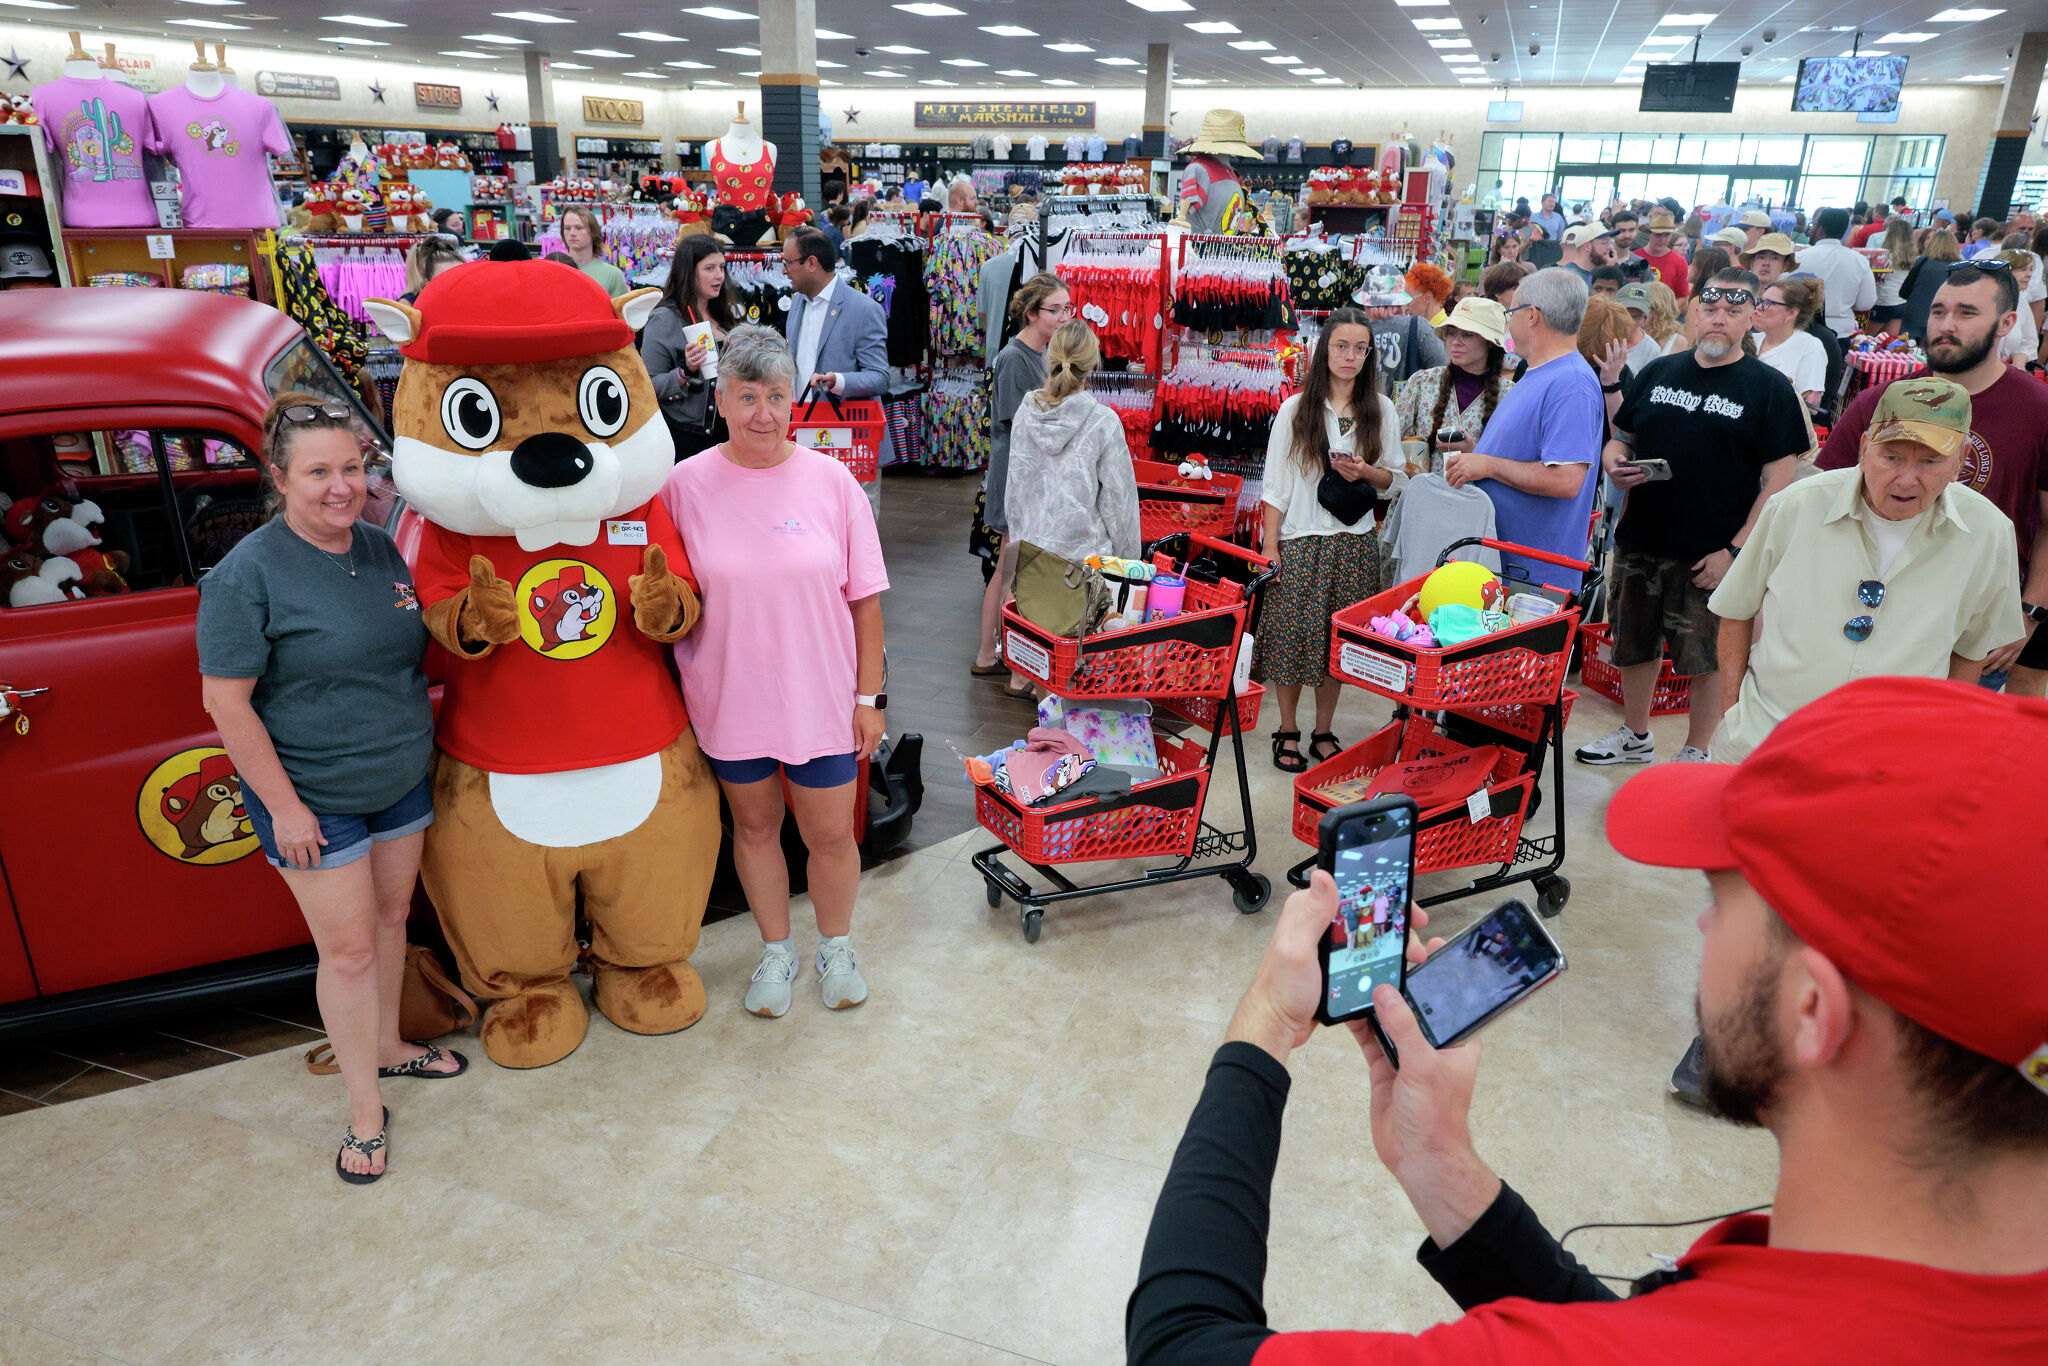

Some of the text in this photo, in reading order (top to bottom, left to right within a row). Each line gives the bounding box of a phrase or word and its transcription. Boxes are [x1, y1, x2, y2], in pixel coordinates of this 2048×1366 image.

[418, 86, 460, 104] STORE
[586, 99, 643, 121] WOOL
[923, 104, 1087, 116] MATT SHEFFIELD
[958, 113, 1050, 124] MARSHALL
[1979, 449, 1990, 473] LORD
[1977, 473, 1988, 483] IS
